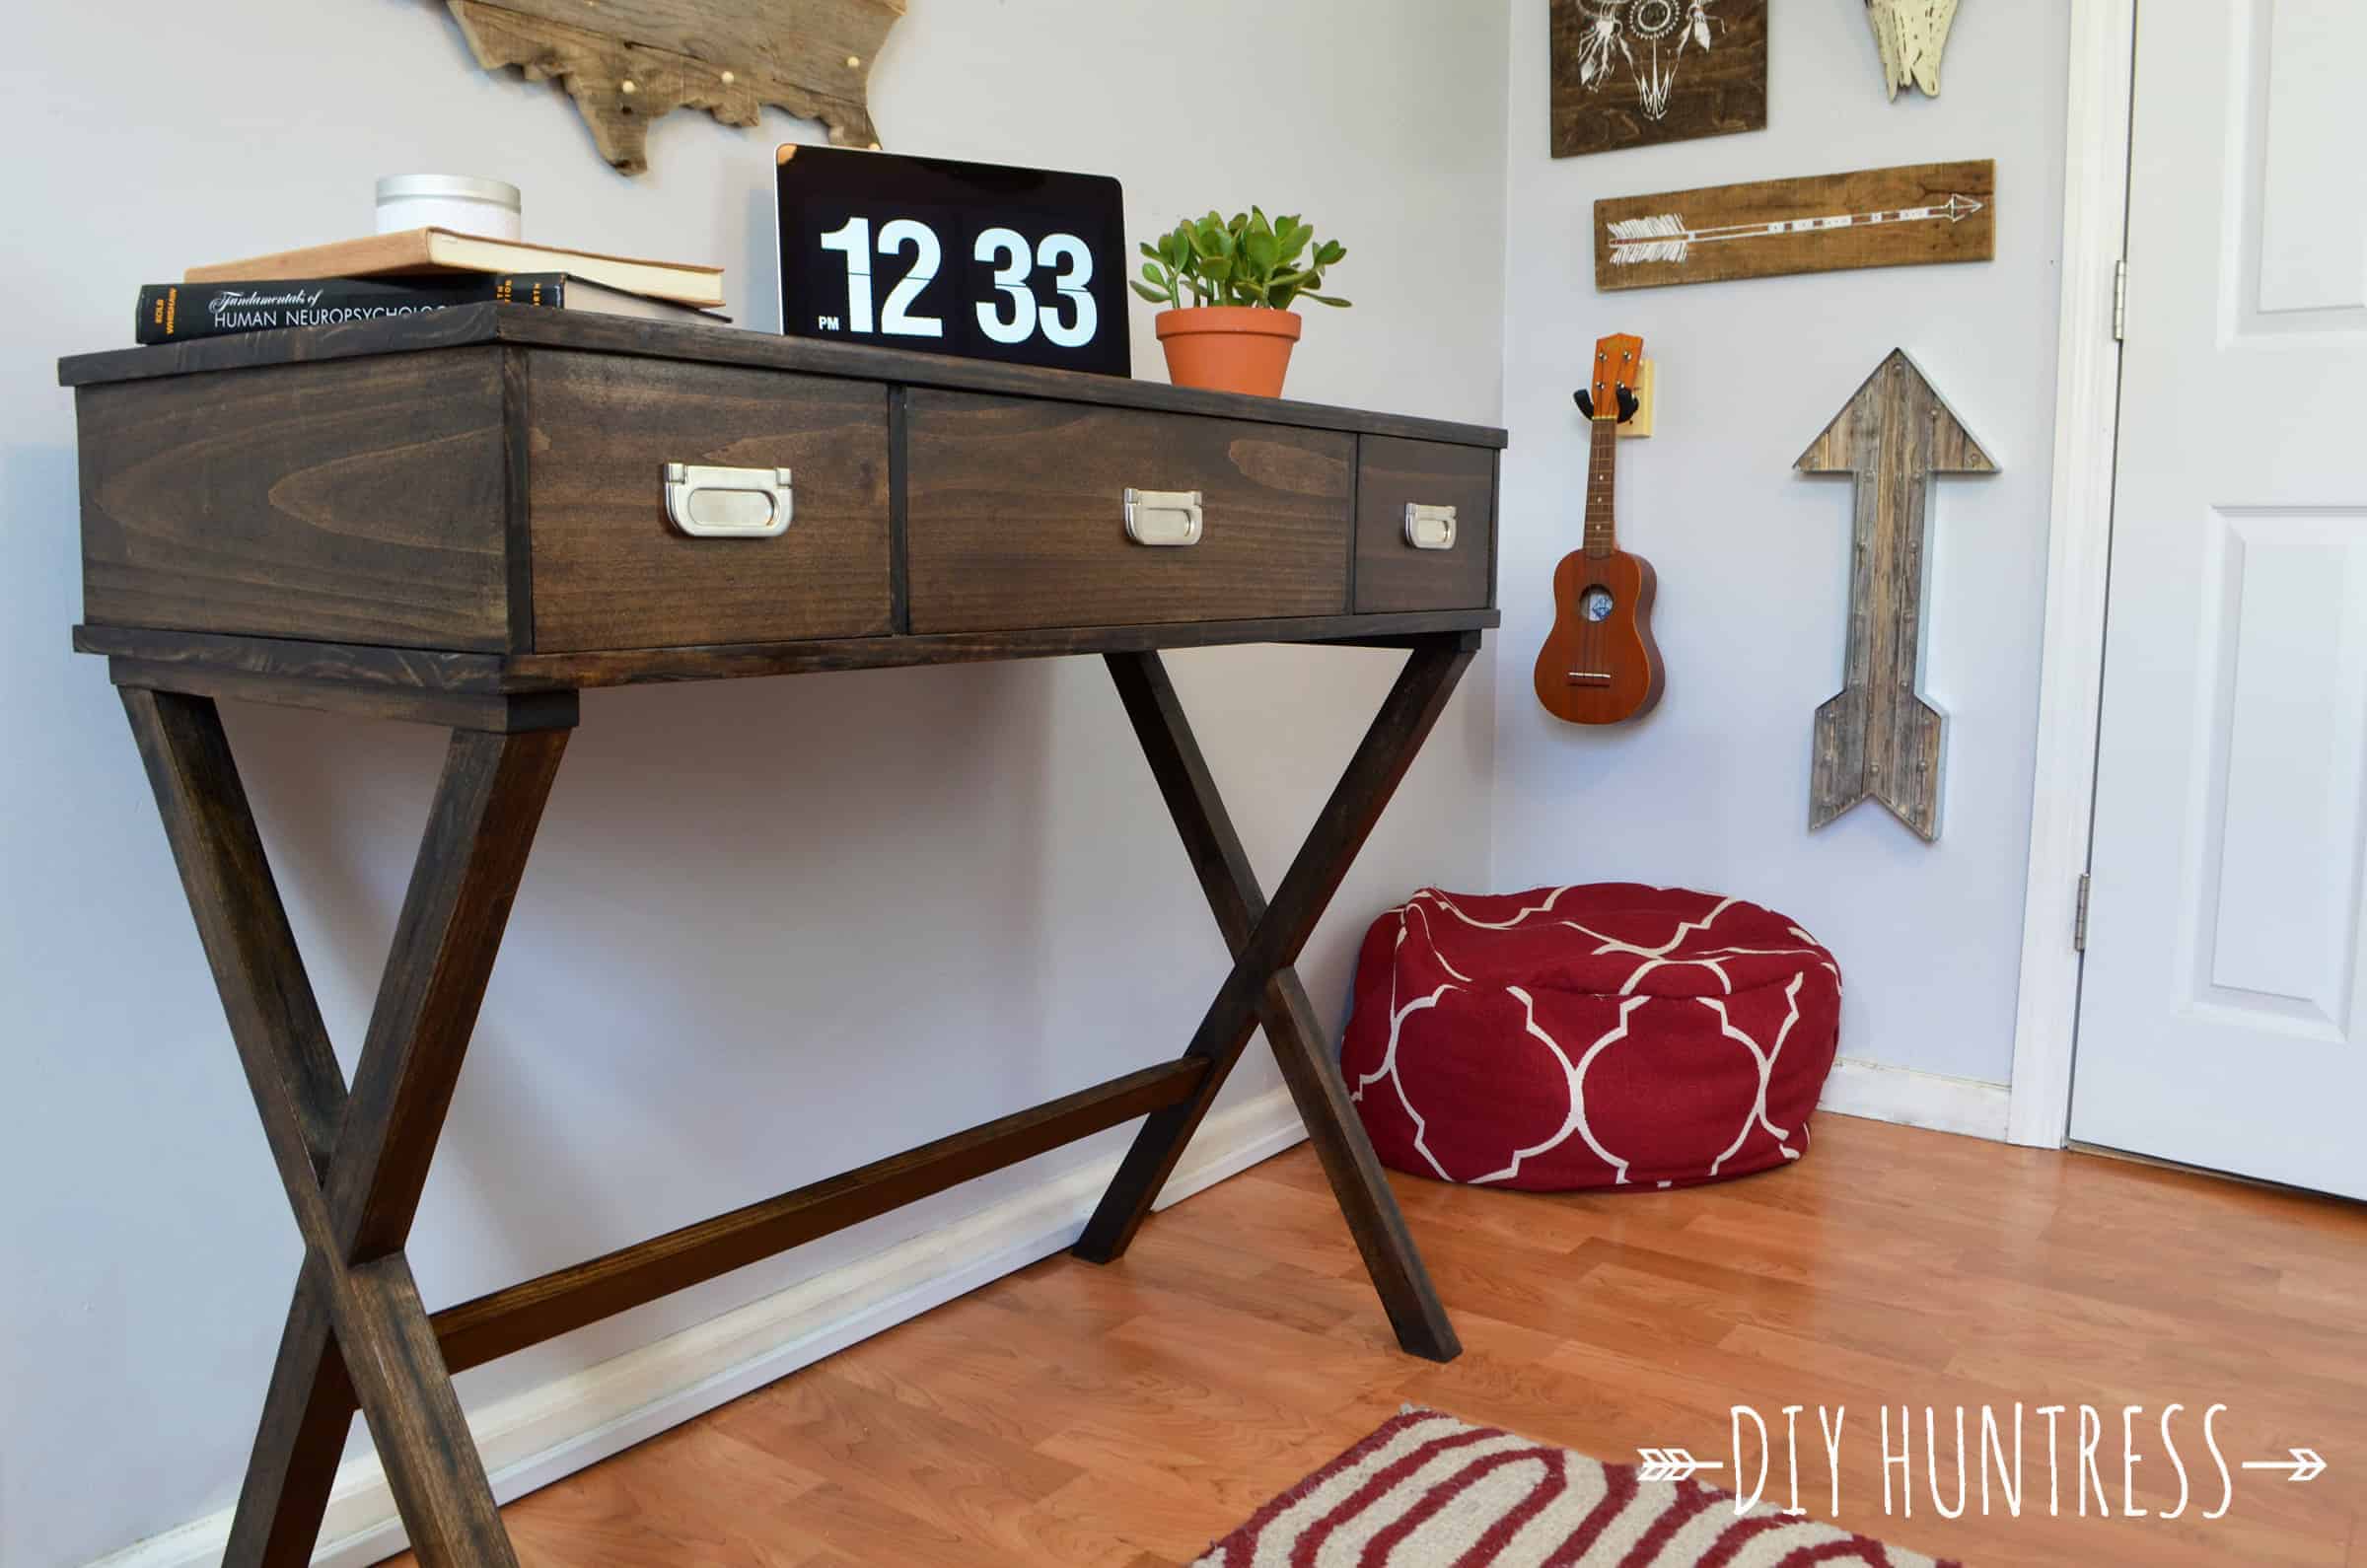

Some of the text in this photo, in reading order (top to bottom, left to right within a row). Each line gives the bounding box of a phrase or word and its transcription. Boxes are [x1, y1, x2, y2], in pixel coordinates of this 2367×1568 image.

[820, 216, 1098, 348] 12 33
[208, 288, 323, 314] Fundamentals of
[214, 310, 277, 327] HUMAN
[818, 316, 840, 330] PM
